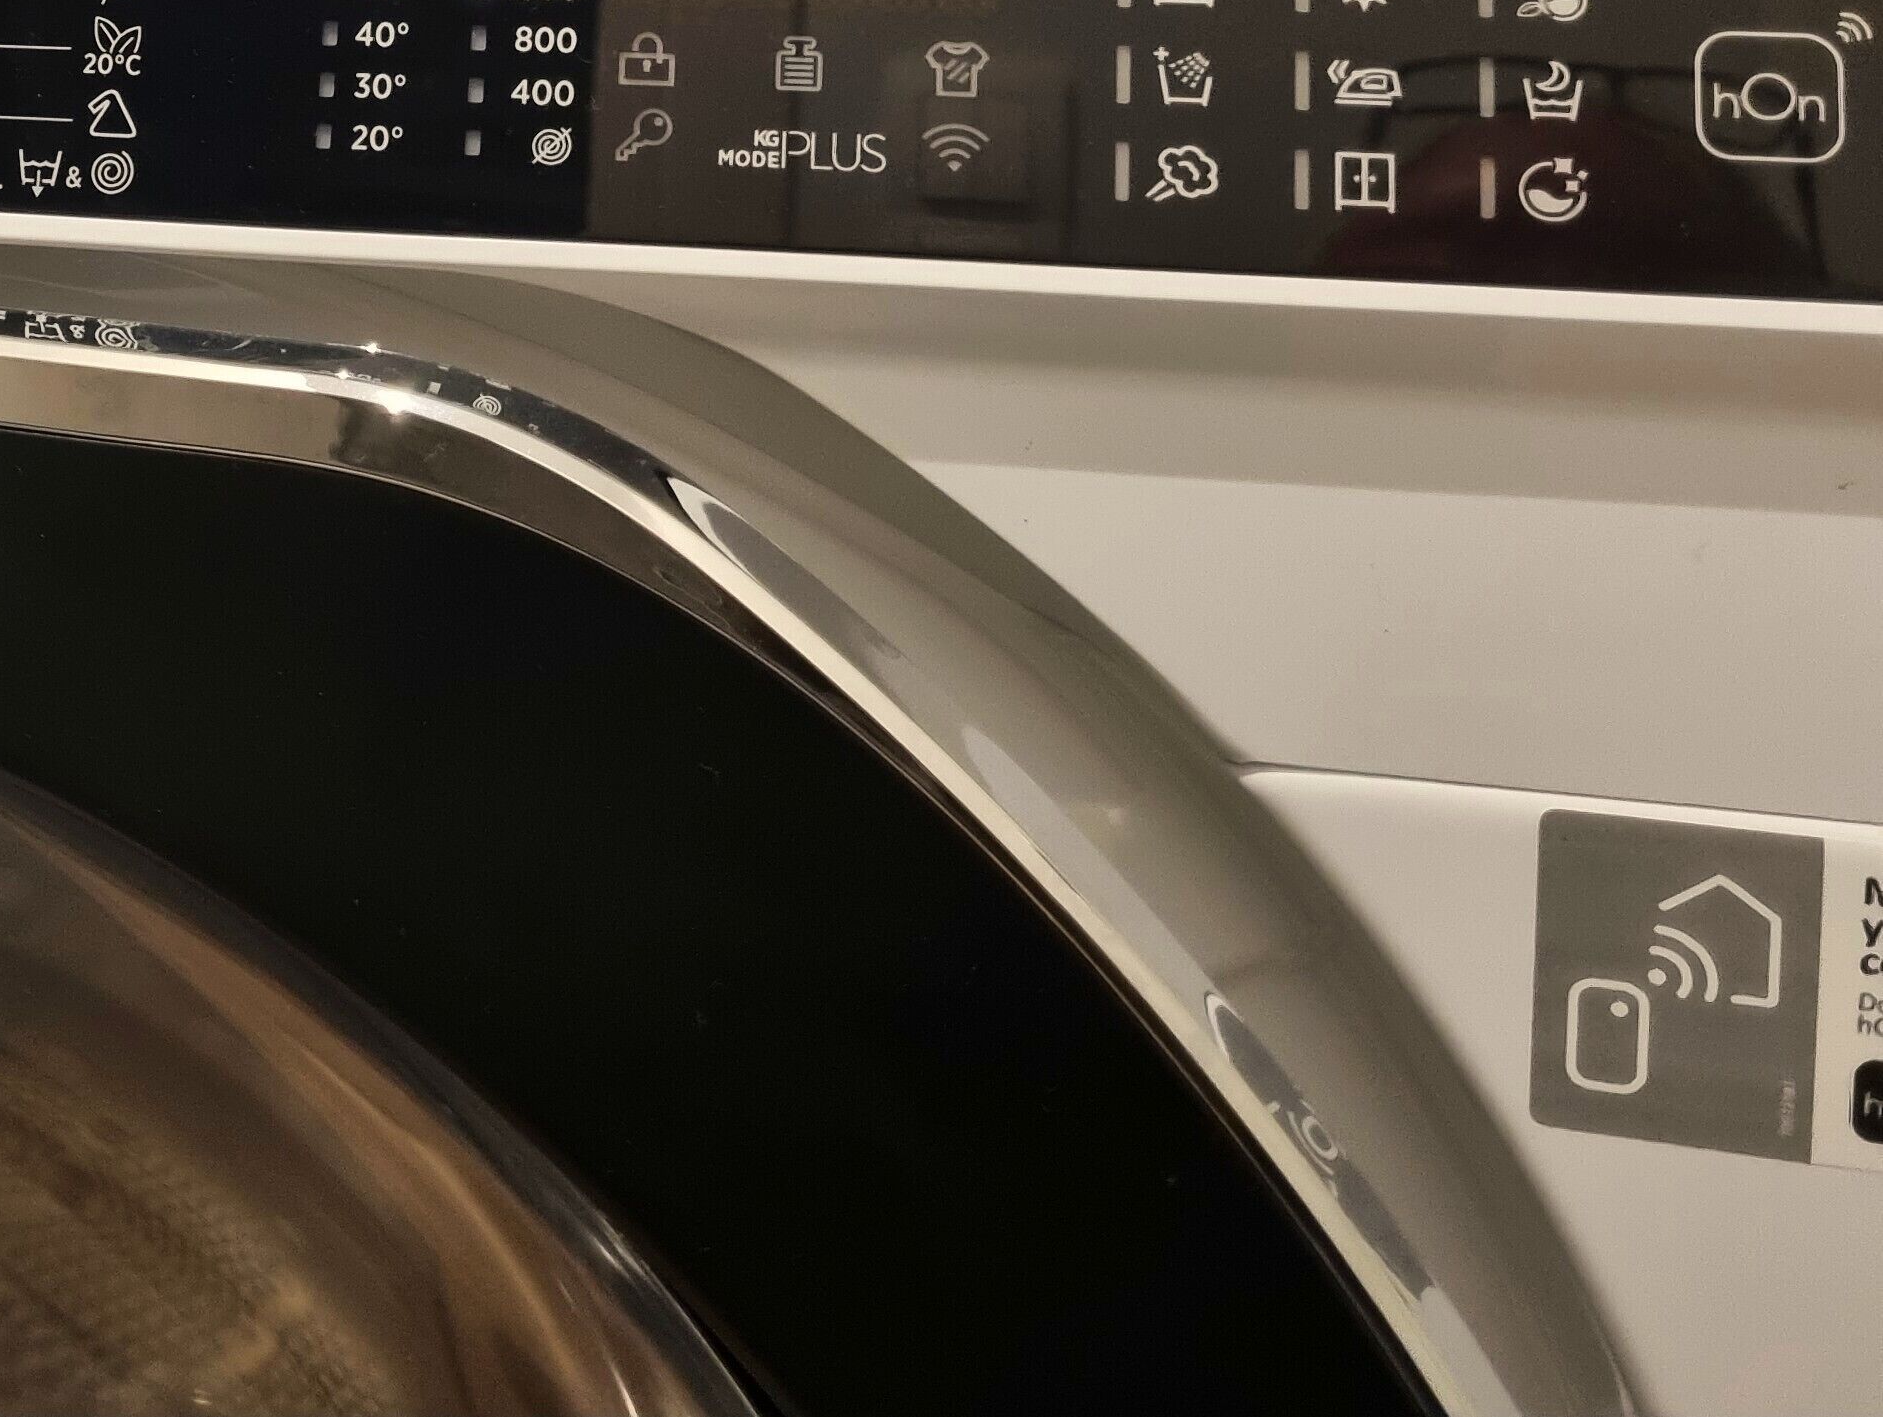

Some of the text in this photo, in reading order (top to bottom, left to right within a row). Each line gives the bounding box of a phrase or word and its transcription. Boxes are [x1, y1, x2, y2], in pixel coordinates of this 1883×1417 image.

[354, 21, 410, 47] 40°
[514, 25, 578, 54] 800
[82, 52, 142, 76] 20°C
[353, 72, 407, 100] 30°
[510, 78, 576, 107] 400
[1712, 72, 1827, 123] hOn
[350, 125, 404, 152] 20°
[752, 129, 781, 148] KG
[780, 129, 888, 174] PLUS
[717, 148, 781, 170] MODE
[65, 165, 83, 189] &
